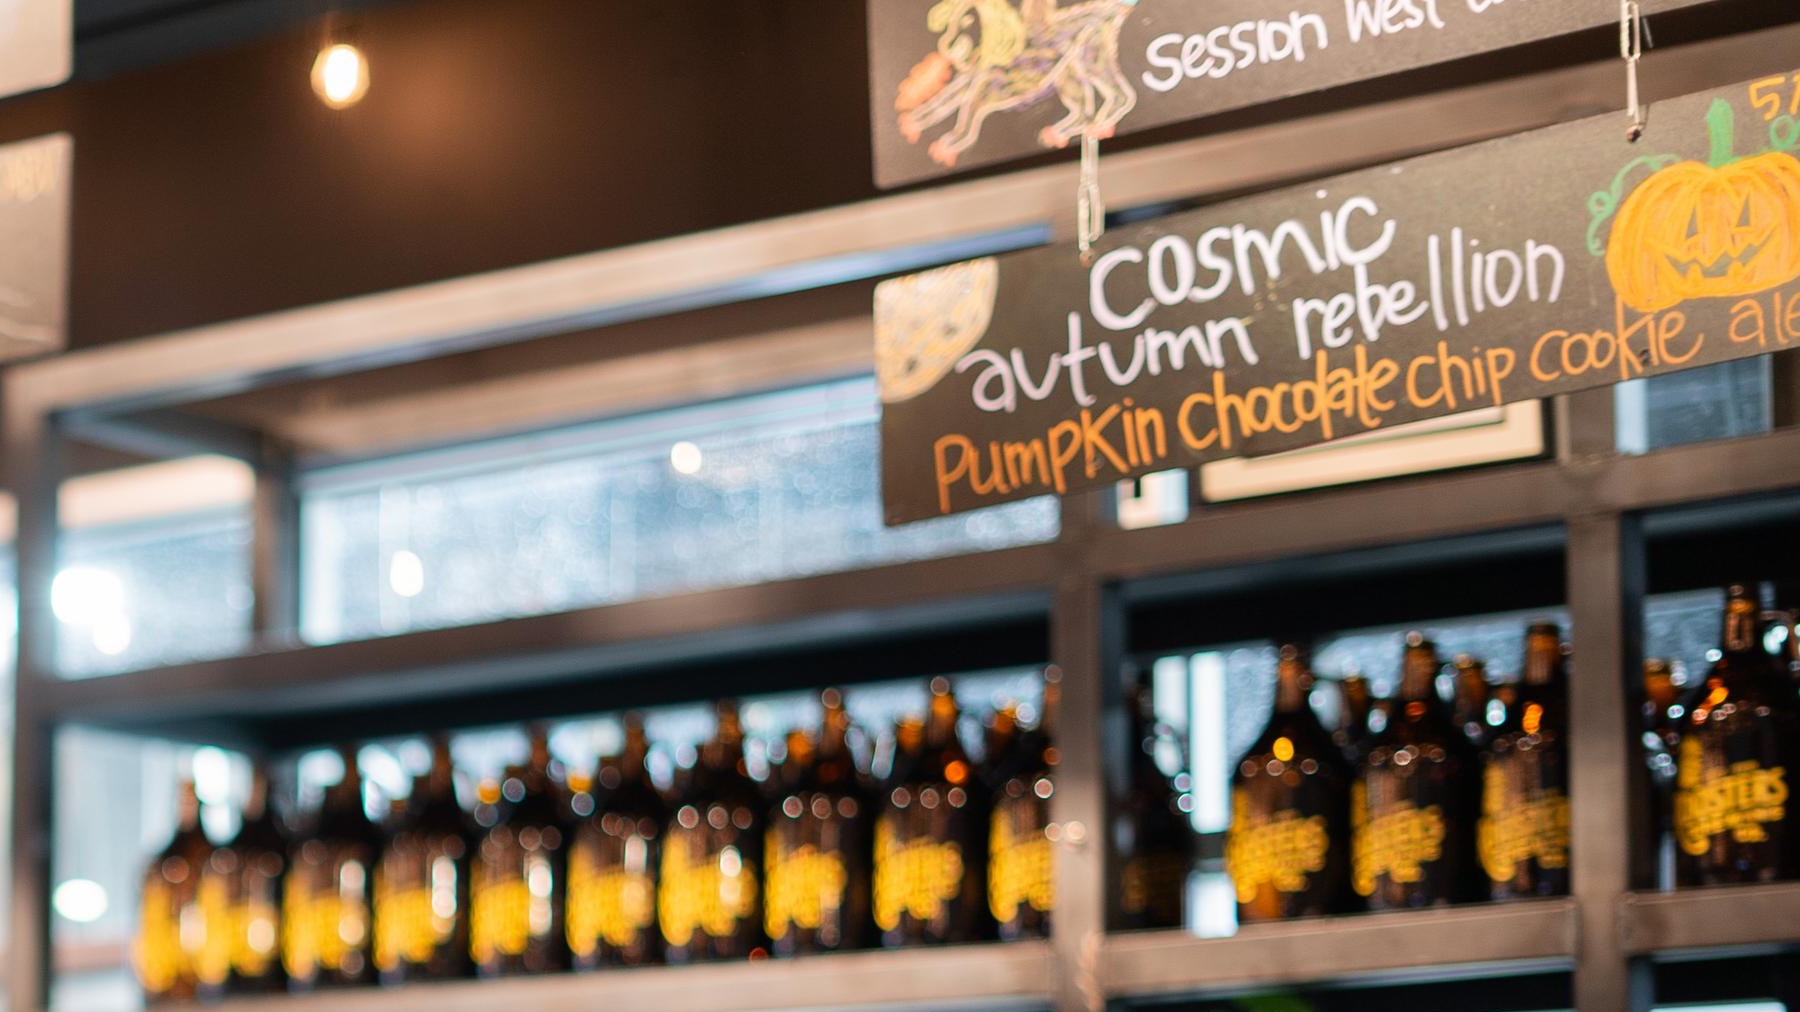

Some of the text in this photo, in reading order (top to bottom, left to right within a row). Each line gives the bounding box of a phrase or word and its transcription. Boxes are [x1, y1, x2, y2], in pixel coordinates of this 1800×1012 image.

[954, 226, 1565, 412] autumn rebellion
[1530, 294, 1705, 379] cookie
